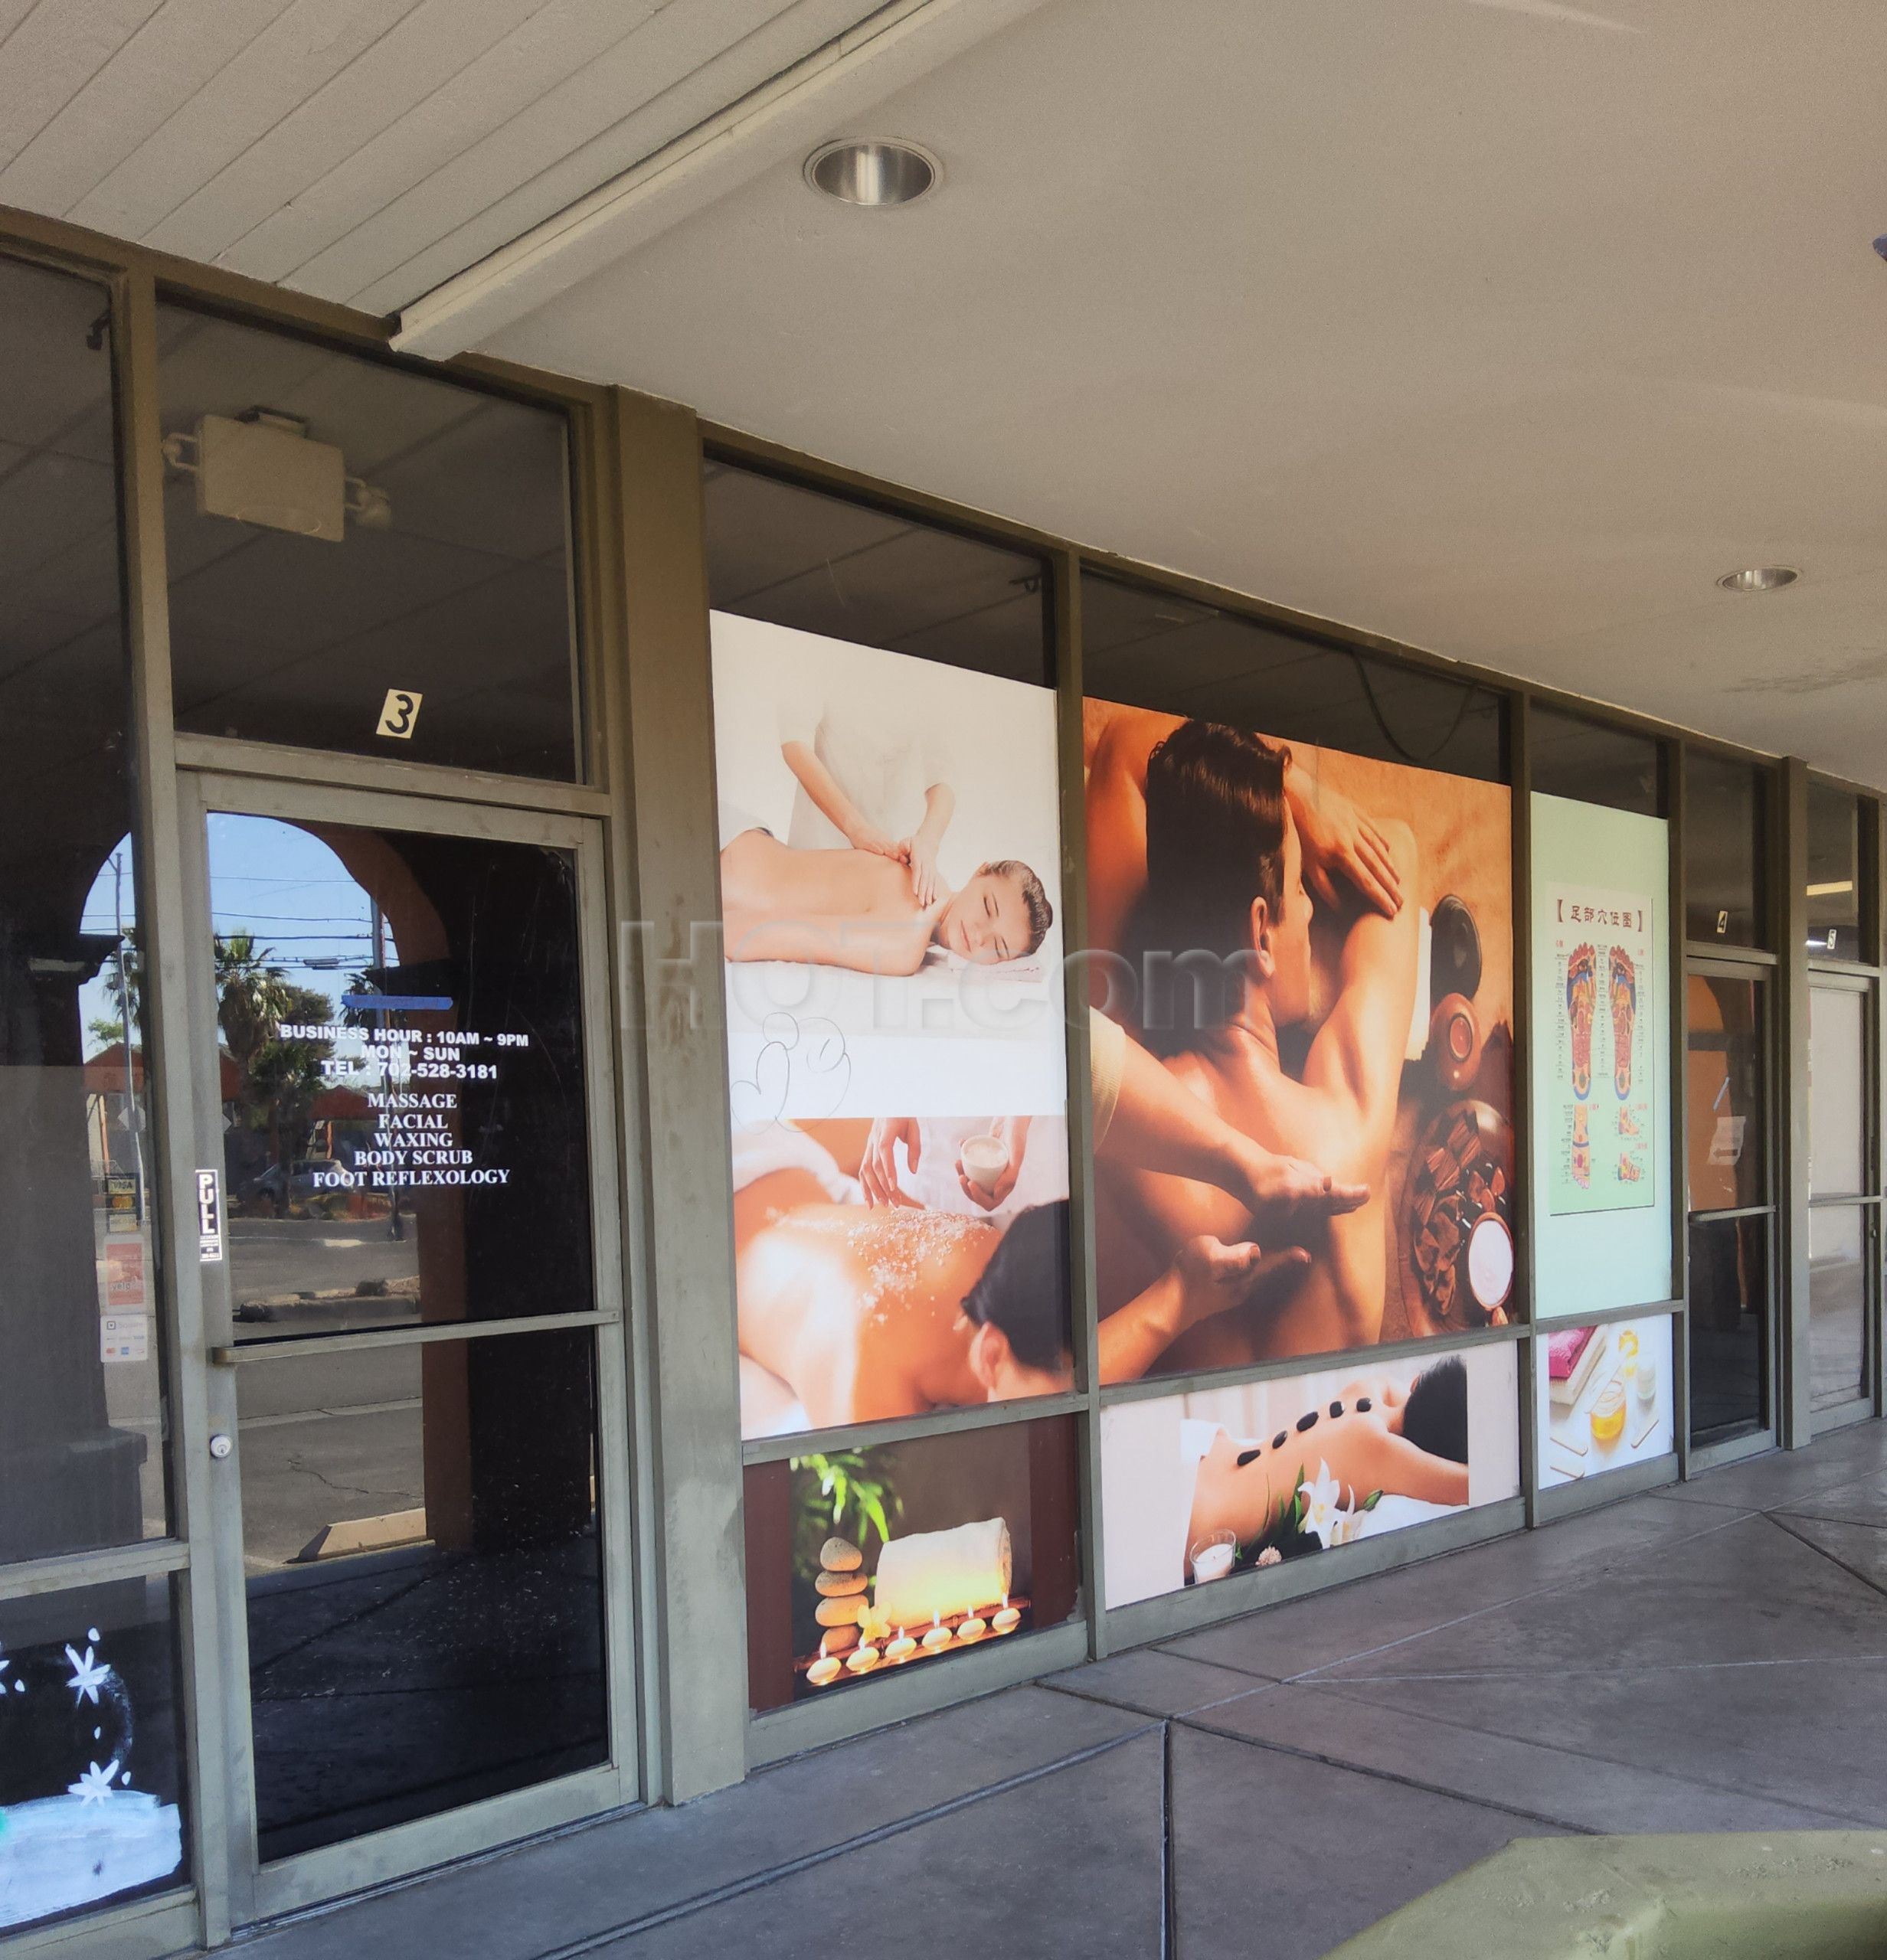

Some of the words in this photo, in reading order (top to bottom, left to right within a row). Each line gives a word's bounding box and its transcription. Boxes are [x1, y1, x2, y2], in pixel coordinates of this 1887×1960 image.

[384, 694, 414, 734] 3
[280, 1024, 369, 1040] BUSINESS
[374, 1028, 423, 1043] HOUR
[427, 1033, 432, 1043] :
[437, 1031, 479, 1045] 10AM
[497, 1034, 529, 1047] 9PM
[361, 1044, 402, 1059] MON
[424, 1047, 460, 1061] SUN
[320, 1060, 360, 1076] TEL
[378, 1061, 497, 1079] 702-528-3181
[368, 1093, 457, 1109] MASSAGE
[378, 1114, 448, 1129] FACIAL
[374, 1132, 453, 1148] WAXING
[354, 1150, 408, 1166] BODY
[412, 1149, 473, 1165] SCRUB
[312, 1171, 368, 1187] FOOT
[372, 1168, 510, 1186] REFLEXOLOGY
[199, 1173, 215, 1234] PULL
